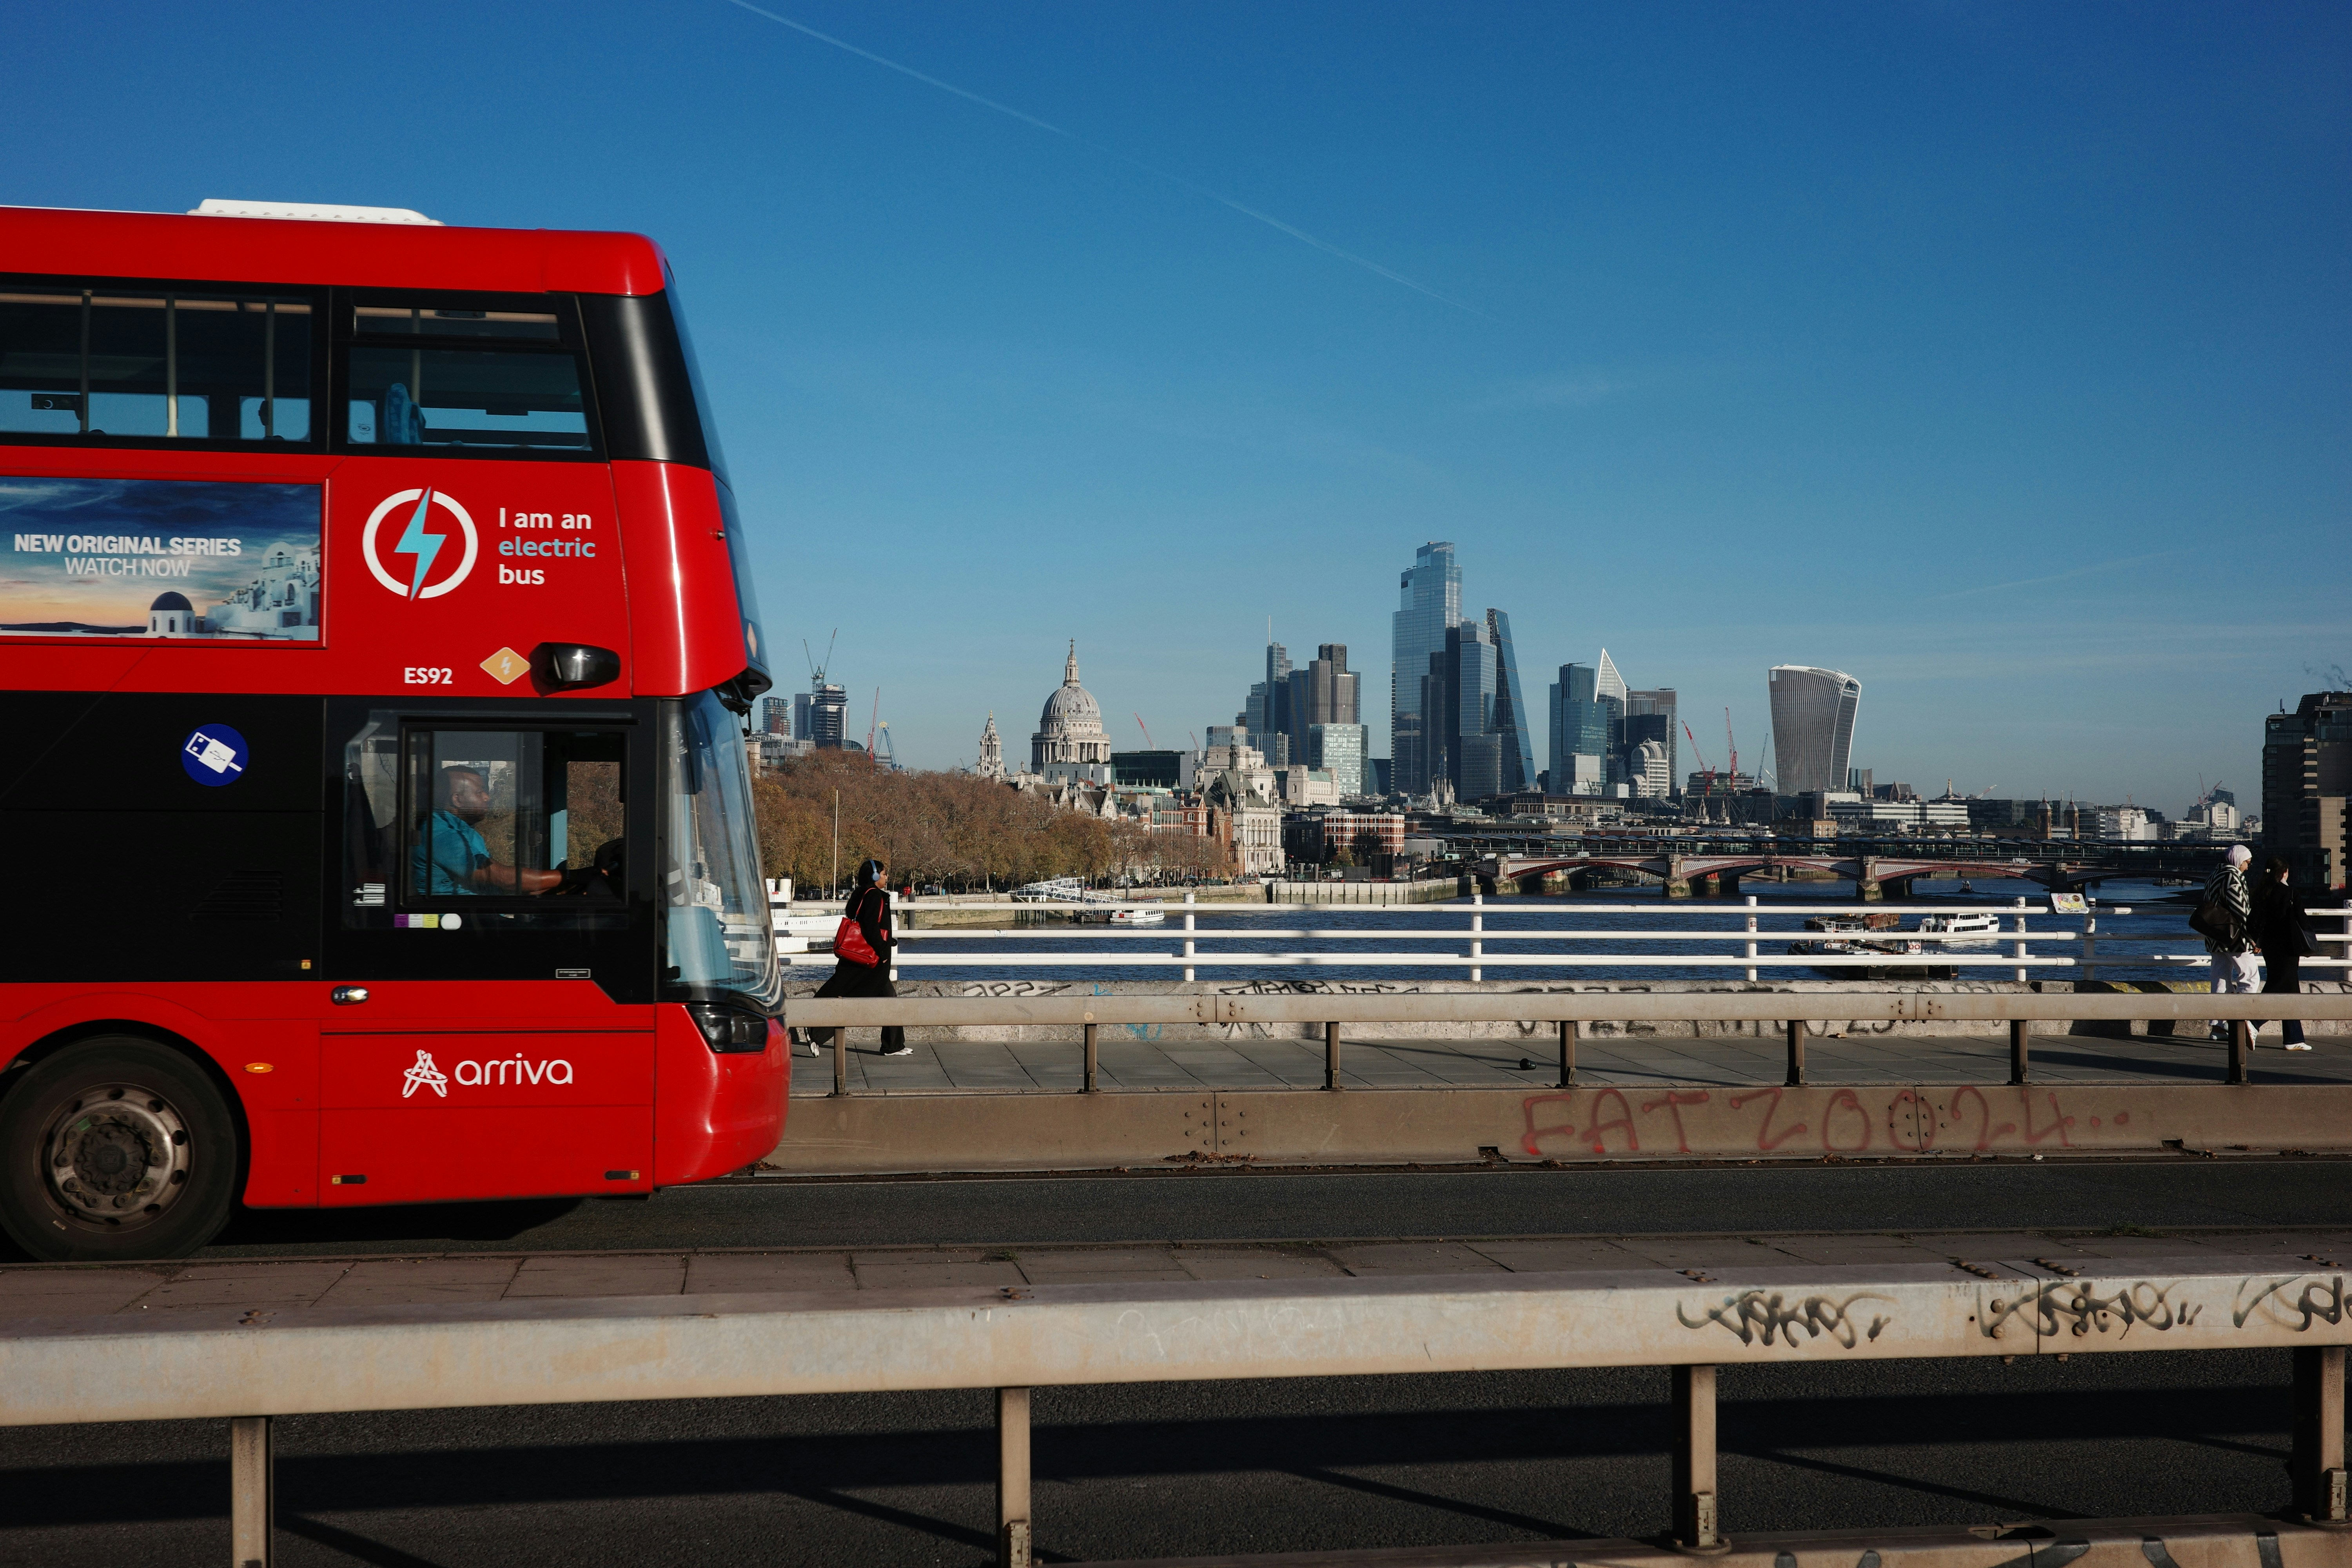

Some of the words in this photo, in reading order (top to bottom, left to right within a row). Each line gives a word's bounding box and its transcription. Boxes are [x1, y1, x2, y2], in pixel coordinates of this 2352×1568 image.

[499, 508, 506, 528] I
[514, 513, 553, 529] am
[561, 514, 592, 530] an
[15, 534, 64, 553] NEW
[67, 535, 167, 555] ORIGINAL
[169, 537, 241, 557] SERIES
[499, 536, 596, 558] electric
[65, 557, 137, 576] WATCH
[142, 558, 191, 577] NOW
[499, 564, 545, 585] bus
[404, 668, 453, 684] ES92
[455, 1053, 573, 1086] arriva
